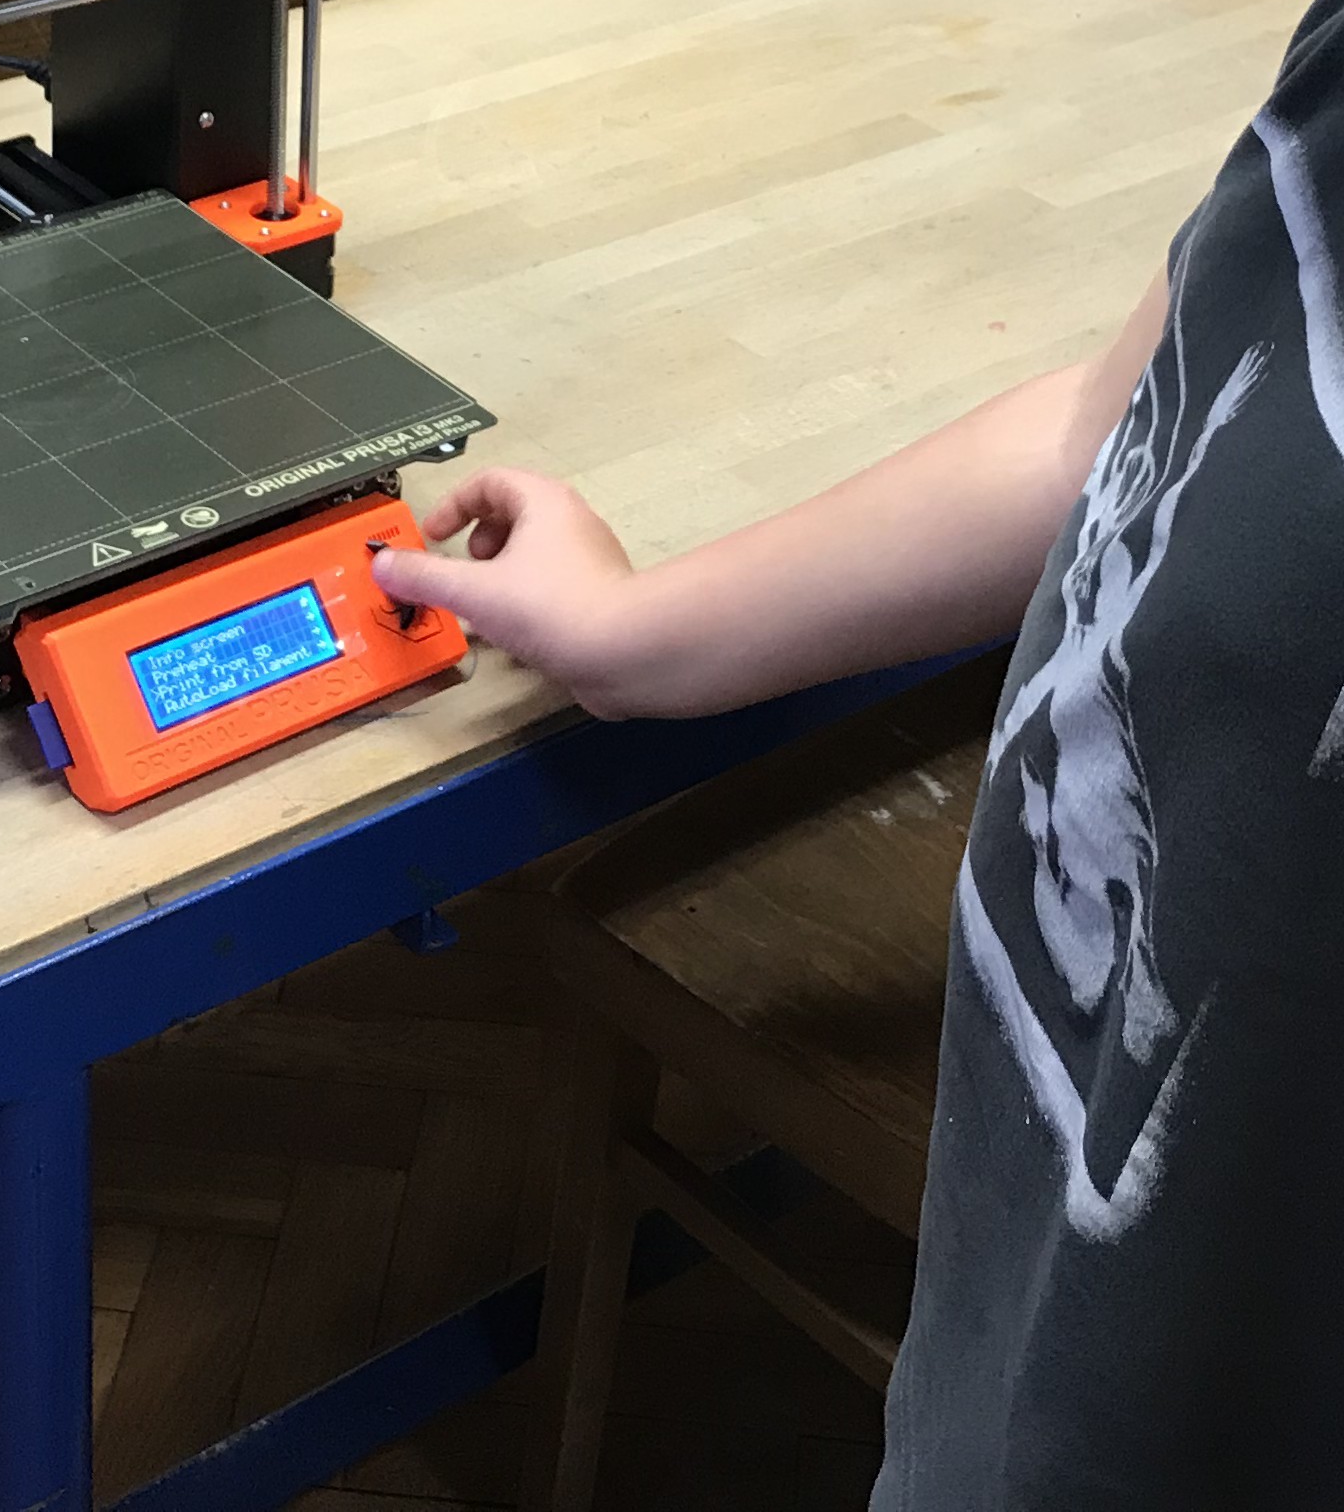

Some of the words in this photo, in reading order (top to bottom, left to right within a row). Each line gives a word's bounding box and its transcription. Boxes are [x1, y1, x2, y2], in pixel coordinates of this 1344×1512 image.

[244, 457, 346, 498] ORIGINAL
[344, 431, 415, 464] PRUSA
[432, 414, 465, 430] MK3
[388, 445, 408, 457] by
[408, 431, 444, 451] Josef
[441, 419, 482, 437] Prusa
[147, 648, 186, 670] Info
[190, 624, 247, 654] screen
[211, 656, 250, 679] from
[252, 644, 273, 661] SD
[242, 645, 312, 683] filament
[152, 652, 217, 685] Preheat
[132, 720, 249, 781] ORIGINAL
